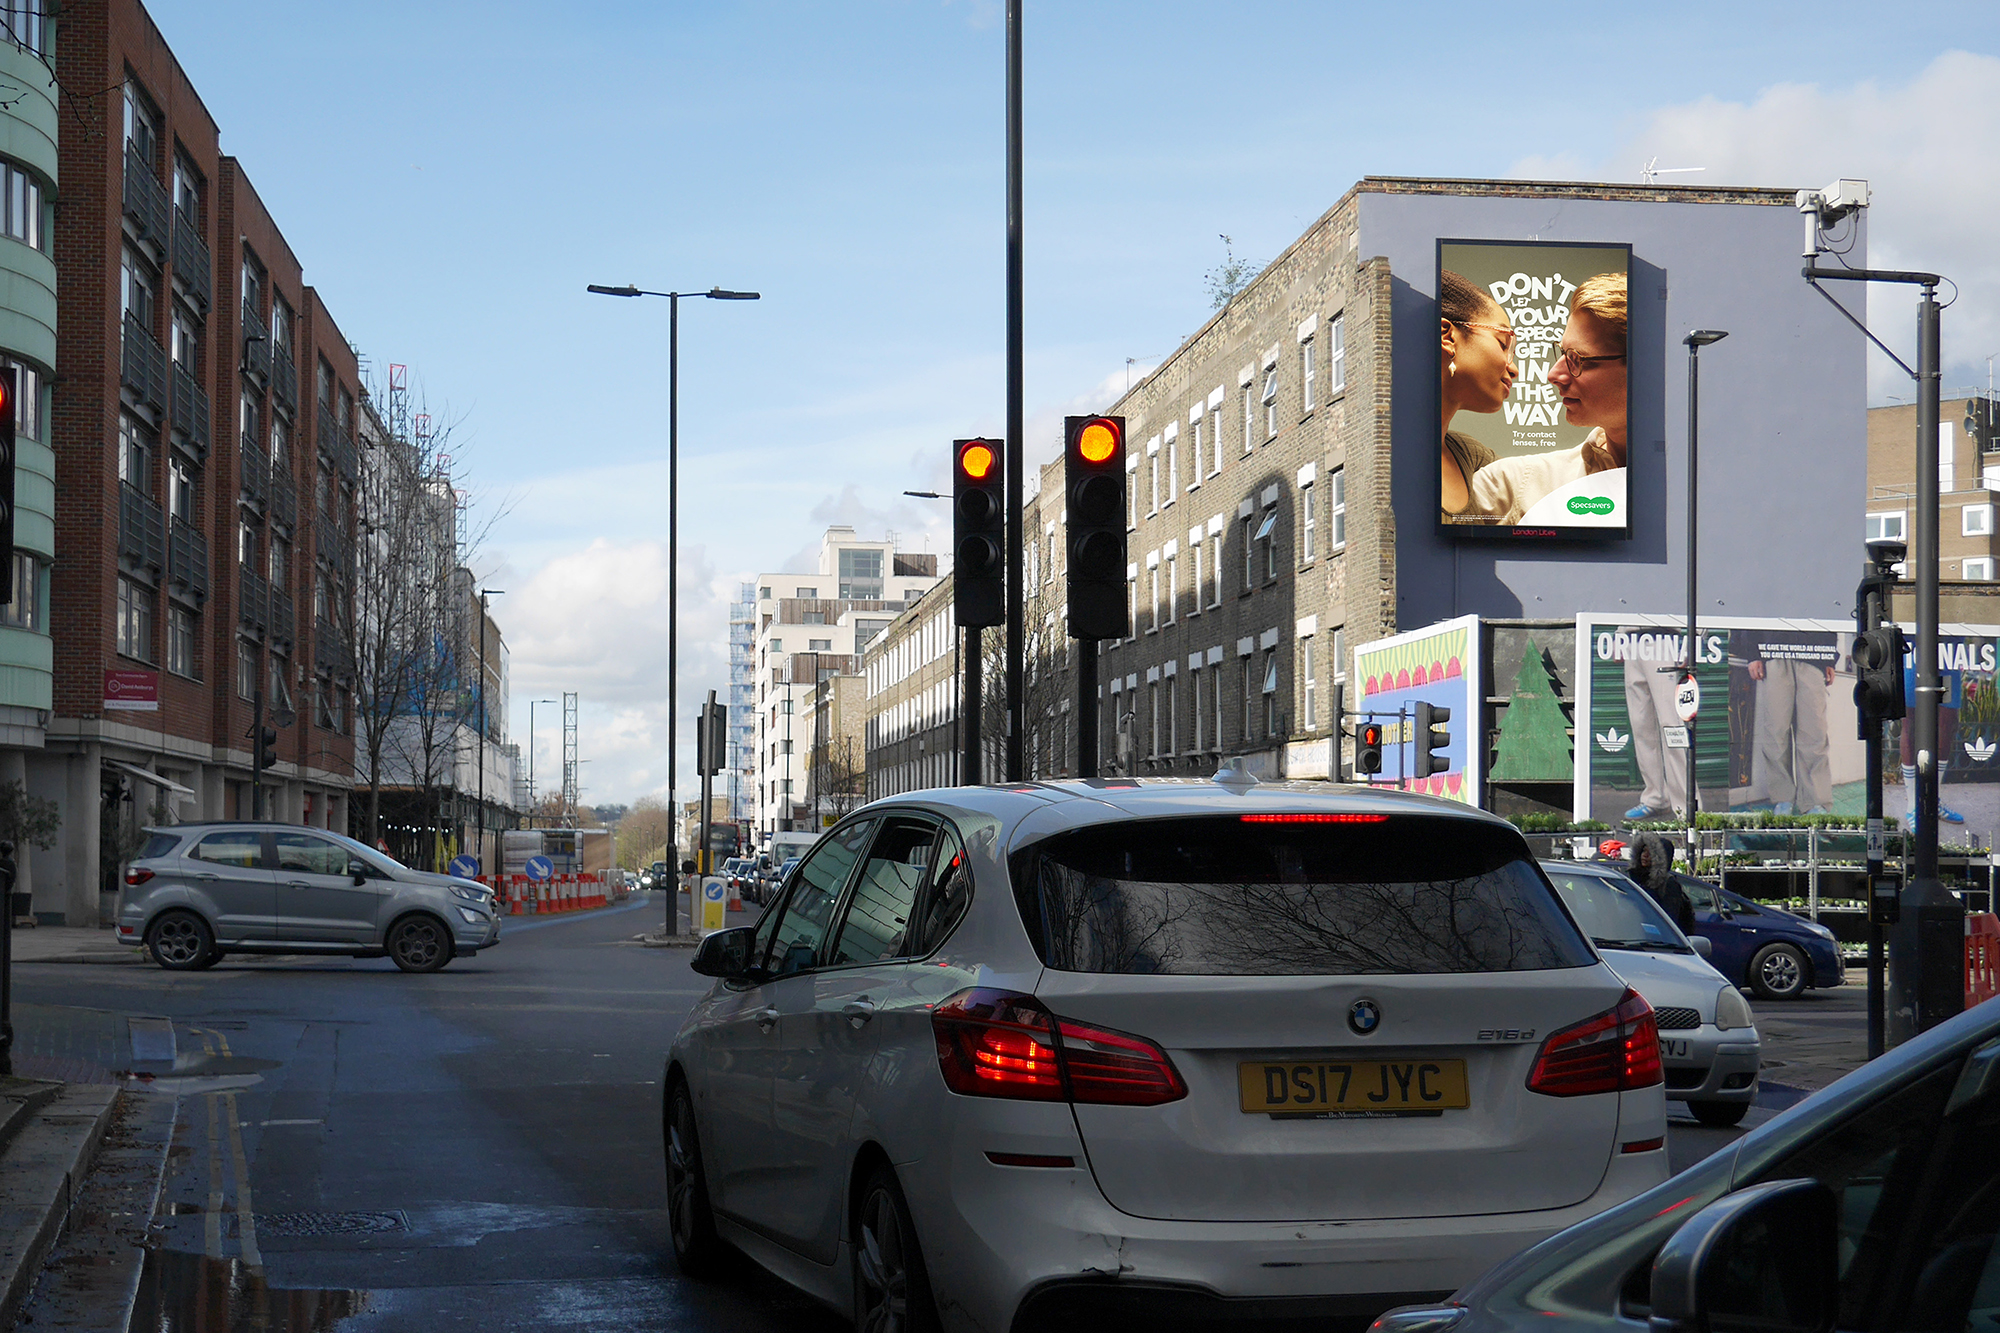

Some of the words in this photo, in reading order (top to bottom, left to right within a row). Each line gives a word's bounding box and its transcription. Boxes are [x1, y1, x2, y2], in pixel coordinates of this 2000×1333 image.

[1488, 272, 1578, 305] DON'T
[1510, 296, 1531, 307] LET
[1504, 304, 1569, 326] YOUR
[1513, 325, 1564, 342] SPECS
[1514, 341, 1552, 359] GET
[1518, 359, 1550, 384] IN
[1512, 382, 1557, 403] THE
[1503, 401, 1563, 427] WAY
[1512, 430, 1525, 439] Try
[1526, 431, 1557, 439] contact
[1512, 439, 1538, 447] lenses,
[1539, 439, 1557, 447] free
[1570, 501, 1611, 510] Specsavers
[1512, 528, 1538, 537] London
[1789, 644, 1806, 652] WORLD
[1477, 1028, 1536, 1040] 216d
[1263, 1065, 1352, 1104] DS17
[1366, 1064, 1443, 1103] JYC
